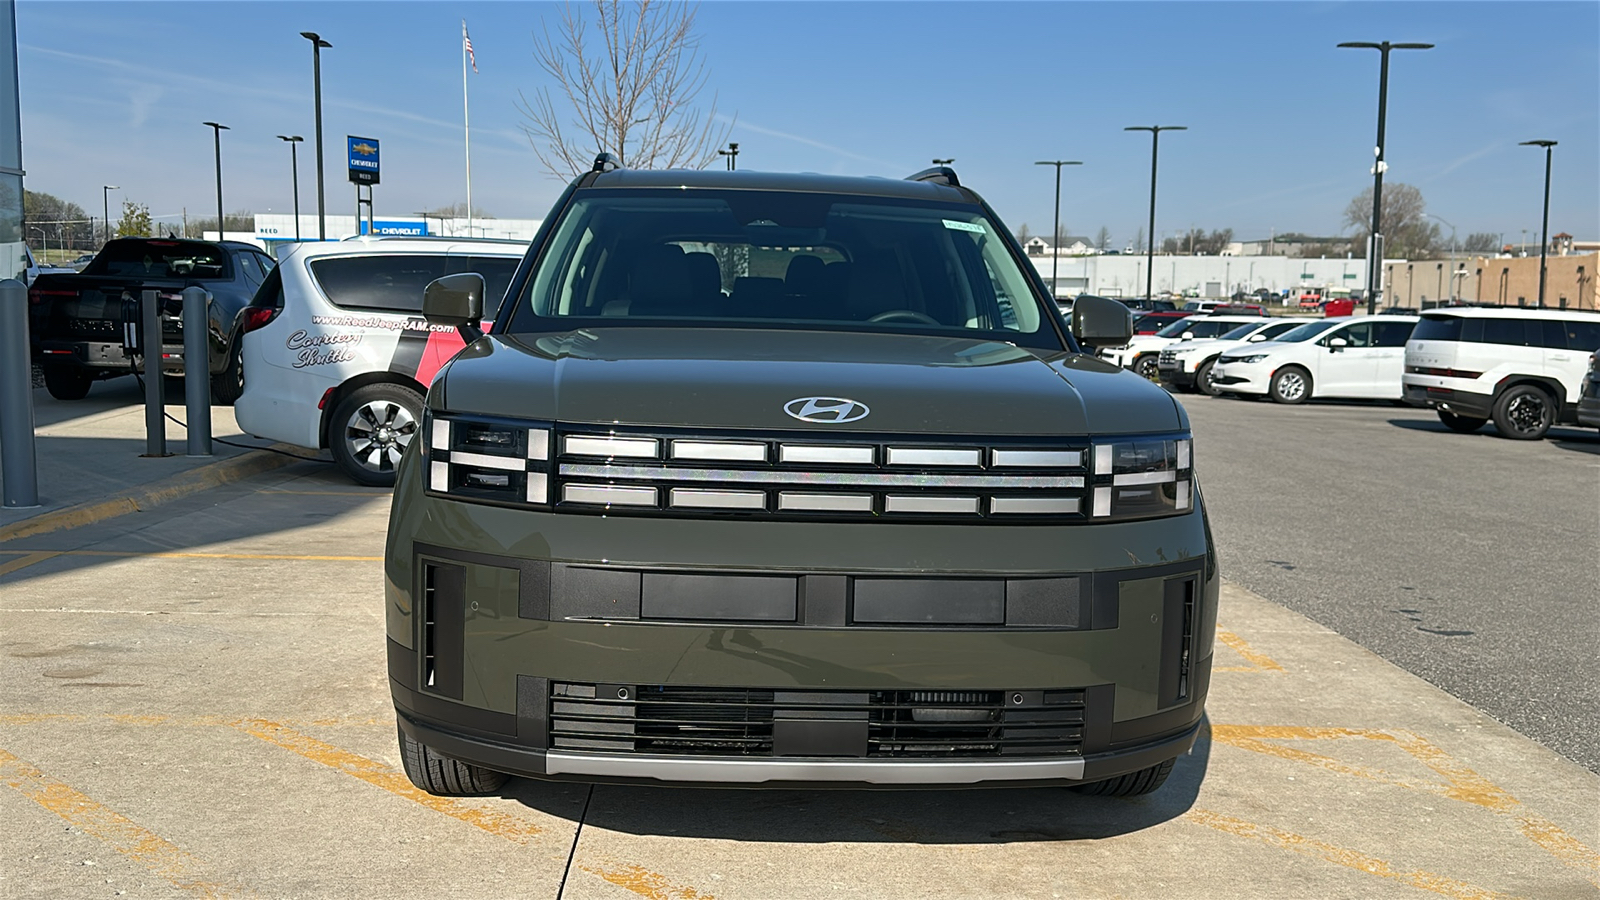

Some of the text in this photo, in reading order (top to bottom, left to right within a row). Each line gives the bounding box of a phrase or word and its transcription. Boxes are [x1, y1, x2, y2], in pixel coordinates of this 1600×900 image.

[351, 159, 378, 168] CHEVROLET
[382, 227, 421, 235] CHEVROLET
[312, 315, 455, 334] www.ReedJeepRAM.com
[286, 329, 365, 350] Courtesy
[292, 347, 356, 368] Shuttle
